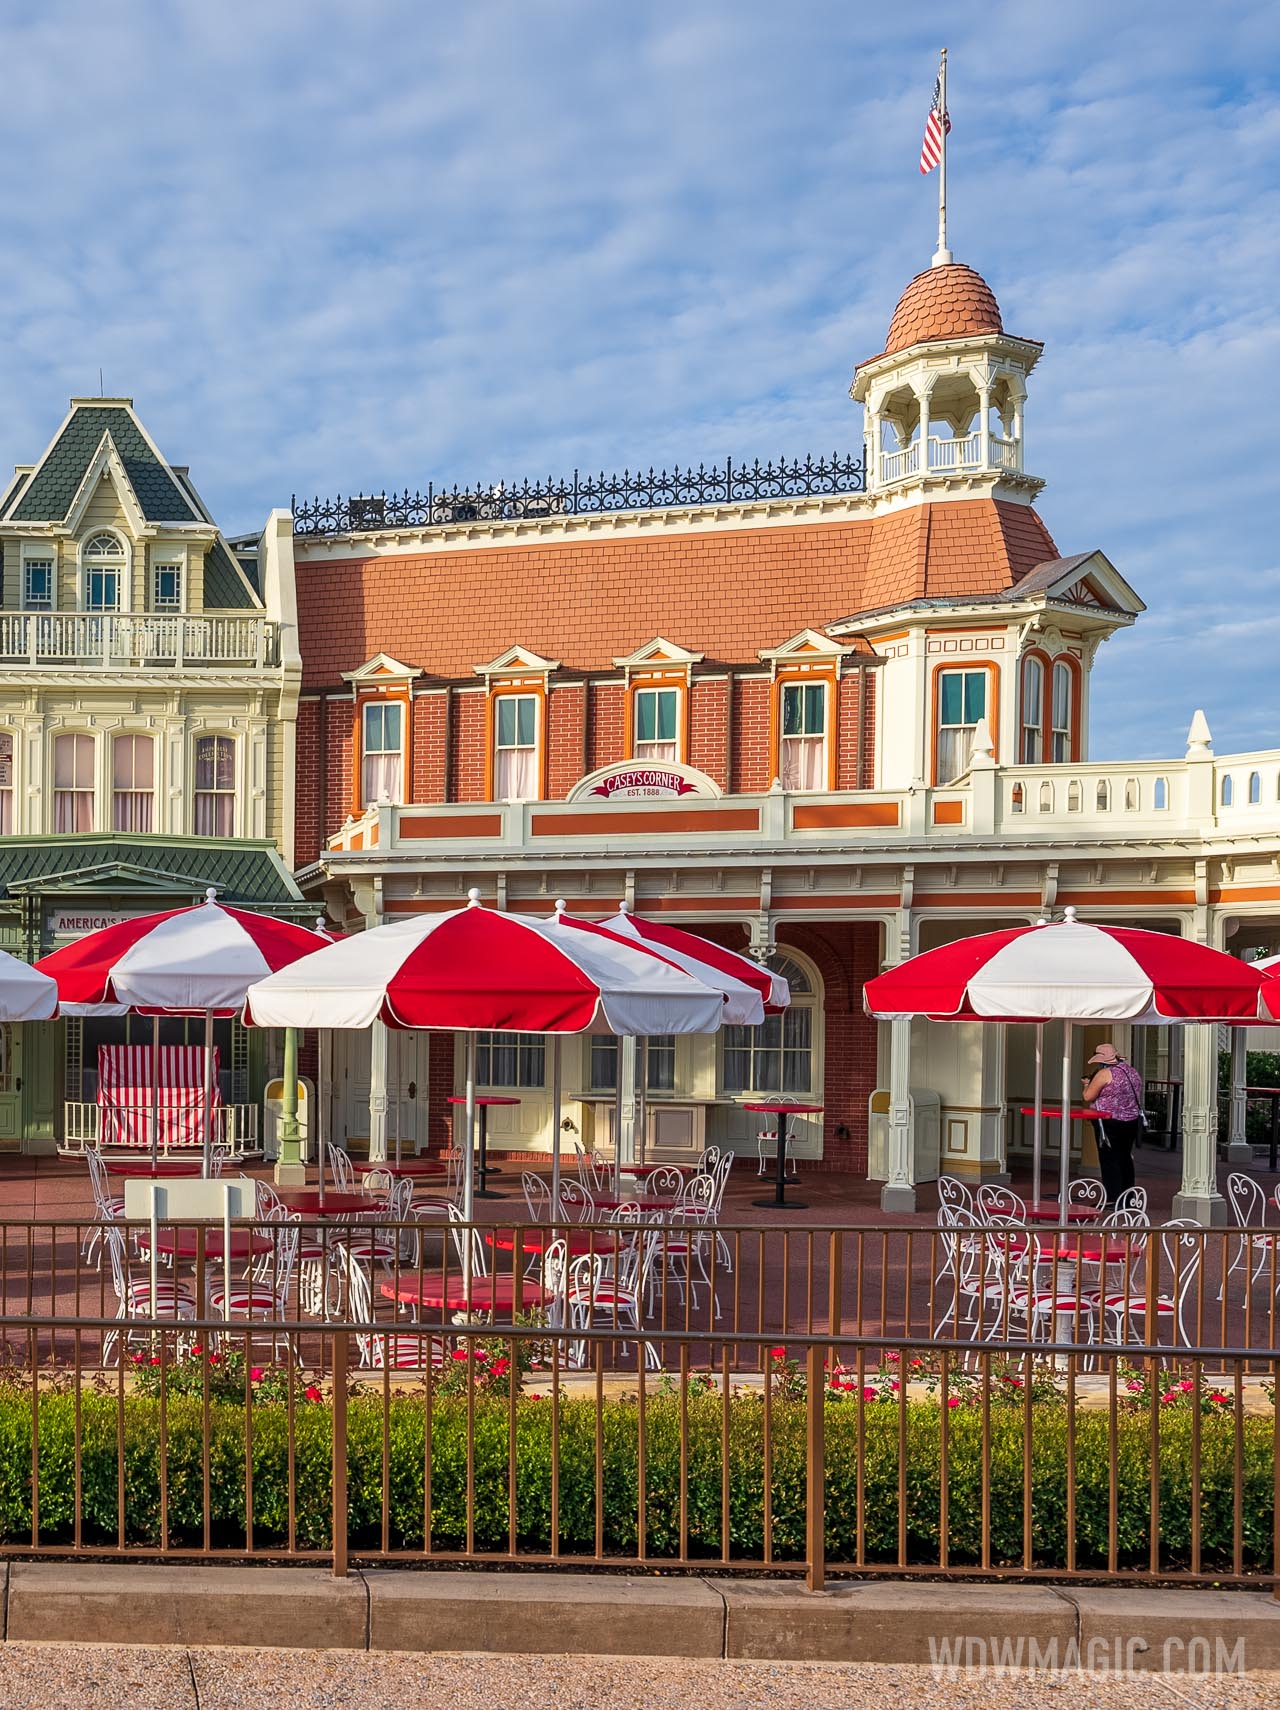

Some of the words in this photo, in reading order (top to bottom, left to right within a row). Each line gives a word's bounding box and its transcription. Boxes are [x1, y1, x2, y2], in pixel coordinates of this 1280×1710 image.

[607, 772, 642, 790] CASEY'S
[644, 772, 680, 790] CORNER
[627, 788, 641, 797] EST.
[643, 788, 660, 796] 1888
[59, 917, 116, 929] AMERICA'S
